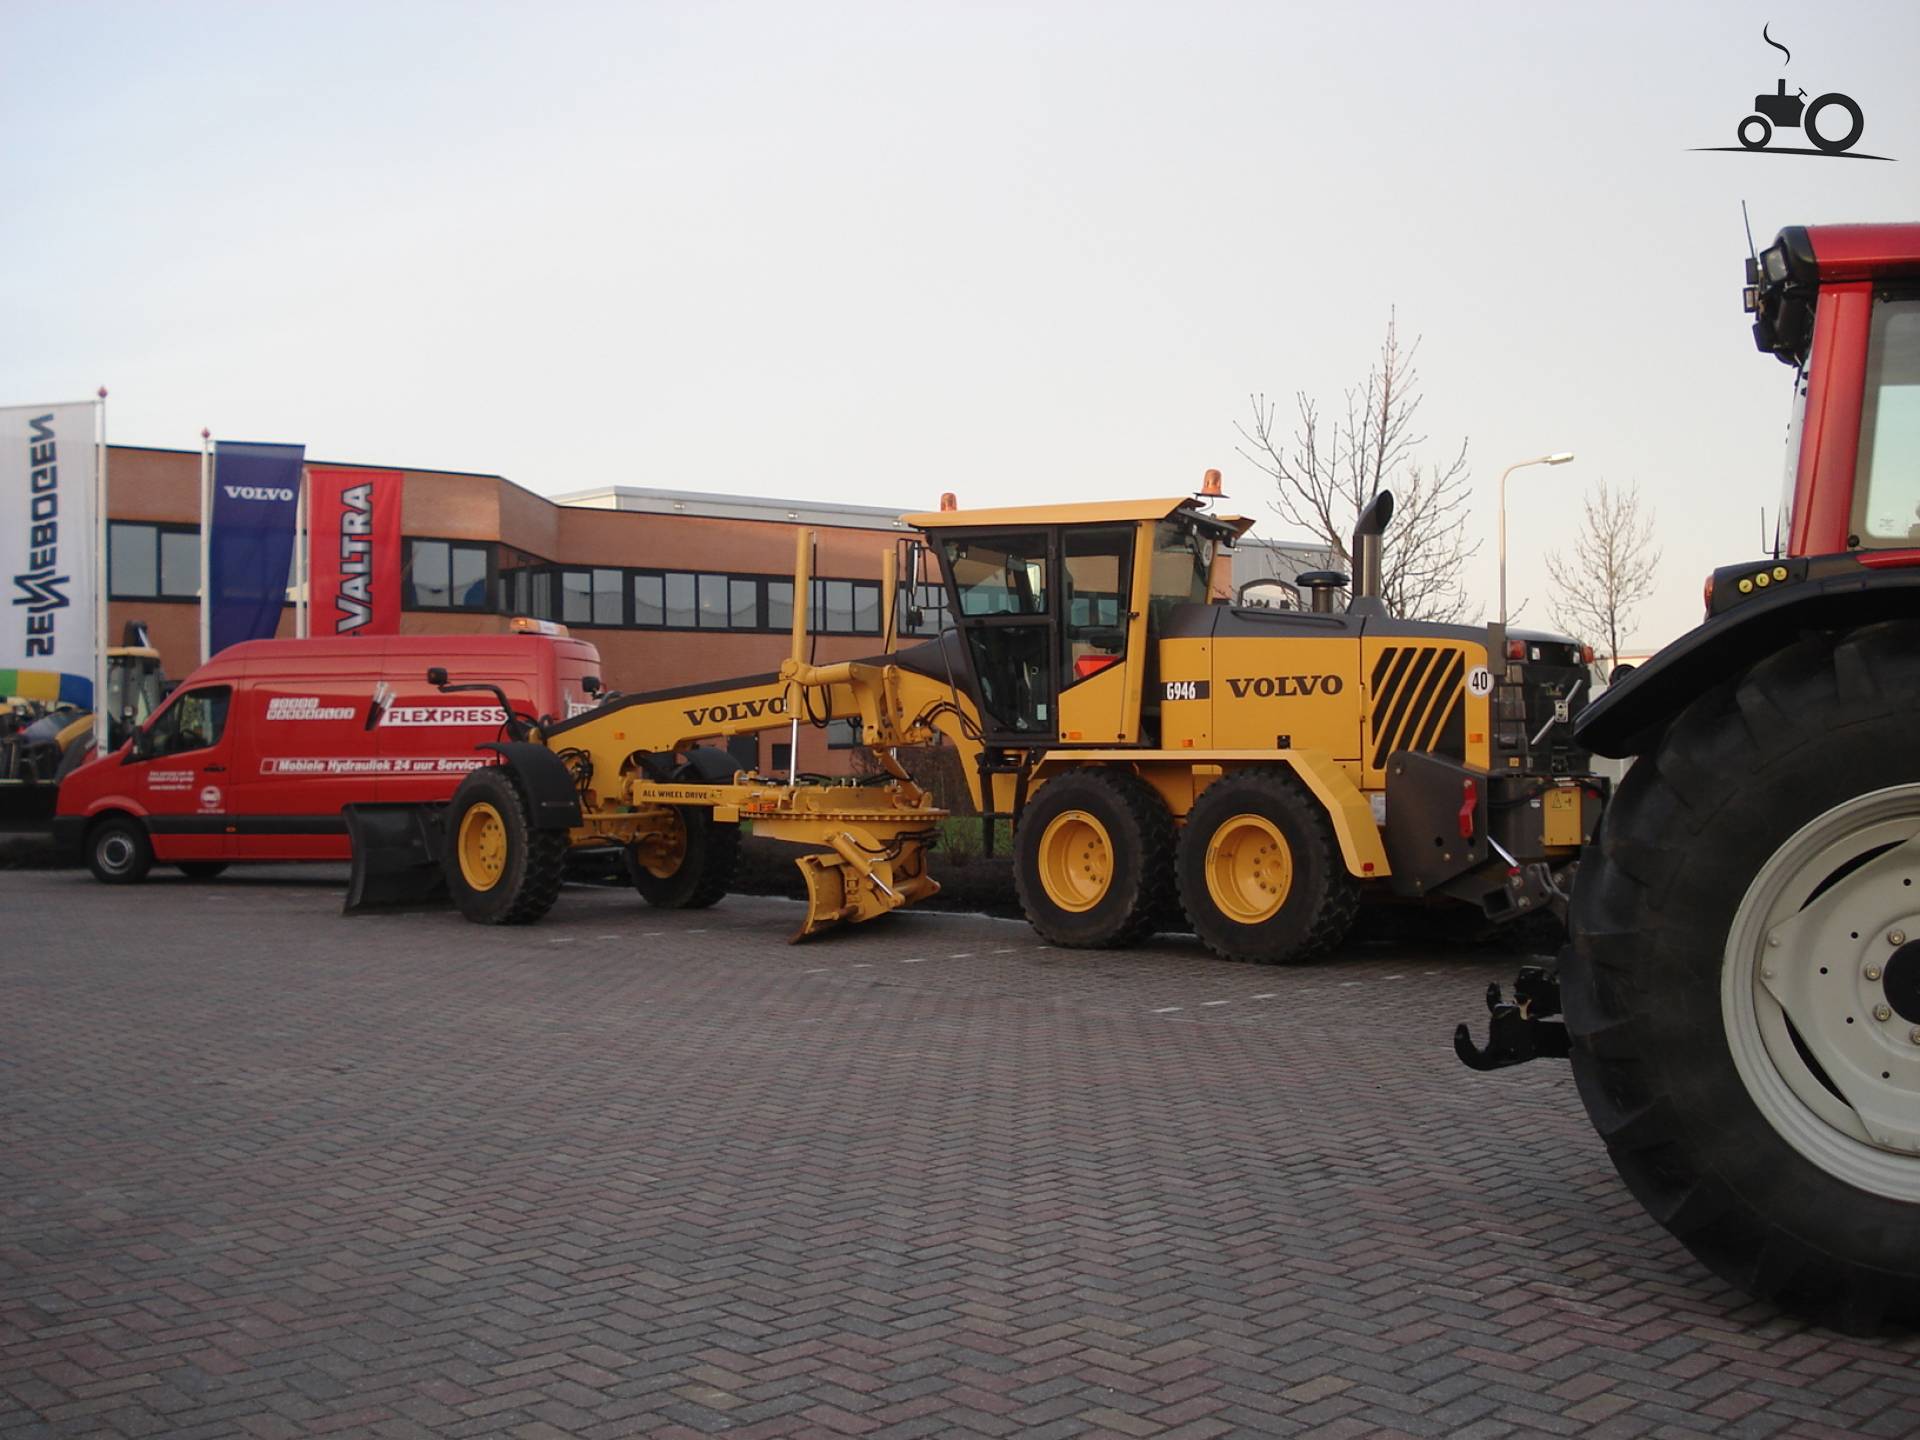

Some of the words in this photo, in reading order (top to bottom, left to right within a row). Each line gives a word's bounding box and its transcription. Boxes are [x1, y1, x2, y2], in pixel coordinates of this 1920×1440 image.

[224, 485, 294, 501] VOLVO
[336, 482, 373, 634] VALTRA
[1226, 674, 1344, 698] VOLVO
[1472, 671, 1488, 690] 40
[1166, 681, 1196, 700] G946
[388, 708, 506, 723] FLEXPRESS
[683, 697, 787, 726] VOLVO
[279, 760, 326, 772] Mobiele
[328, 760, 390, 773] Hydrauliek
[393, 760, 411, 771] 24
[413, 761, 435, 771] uur
[437, 759, 483, 771] Service
[685, 791, 707, 799] DRIVE
